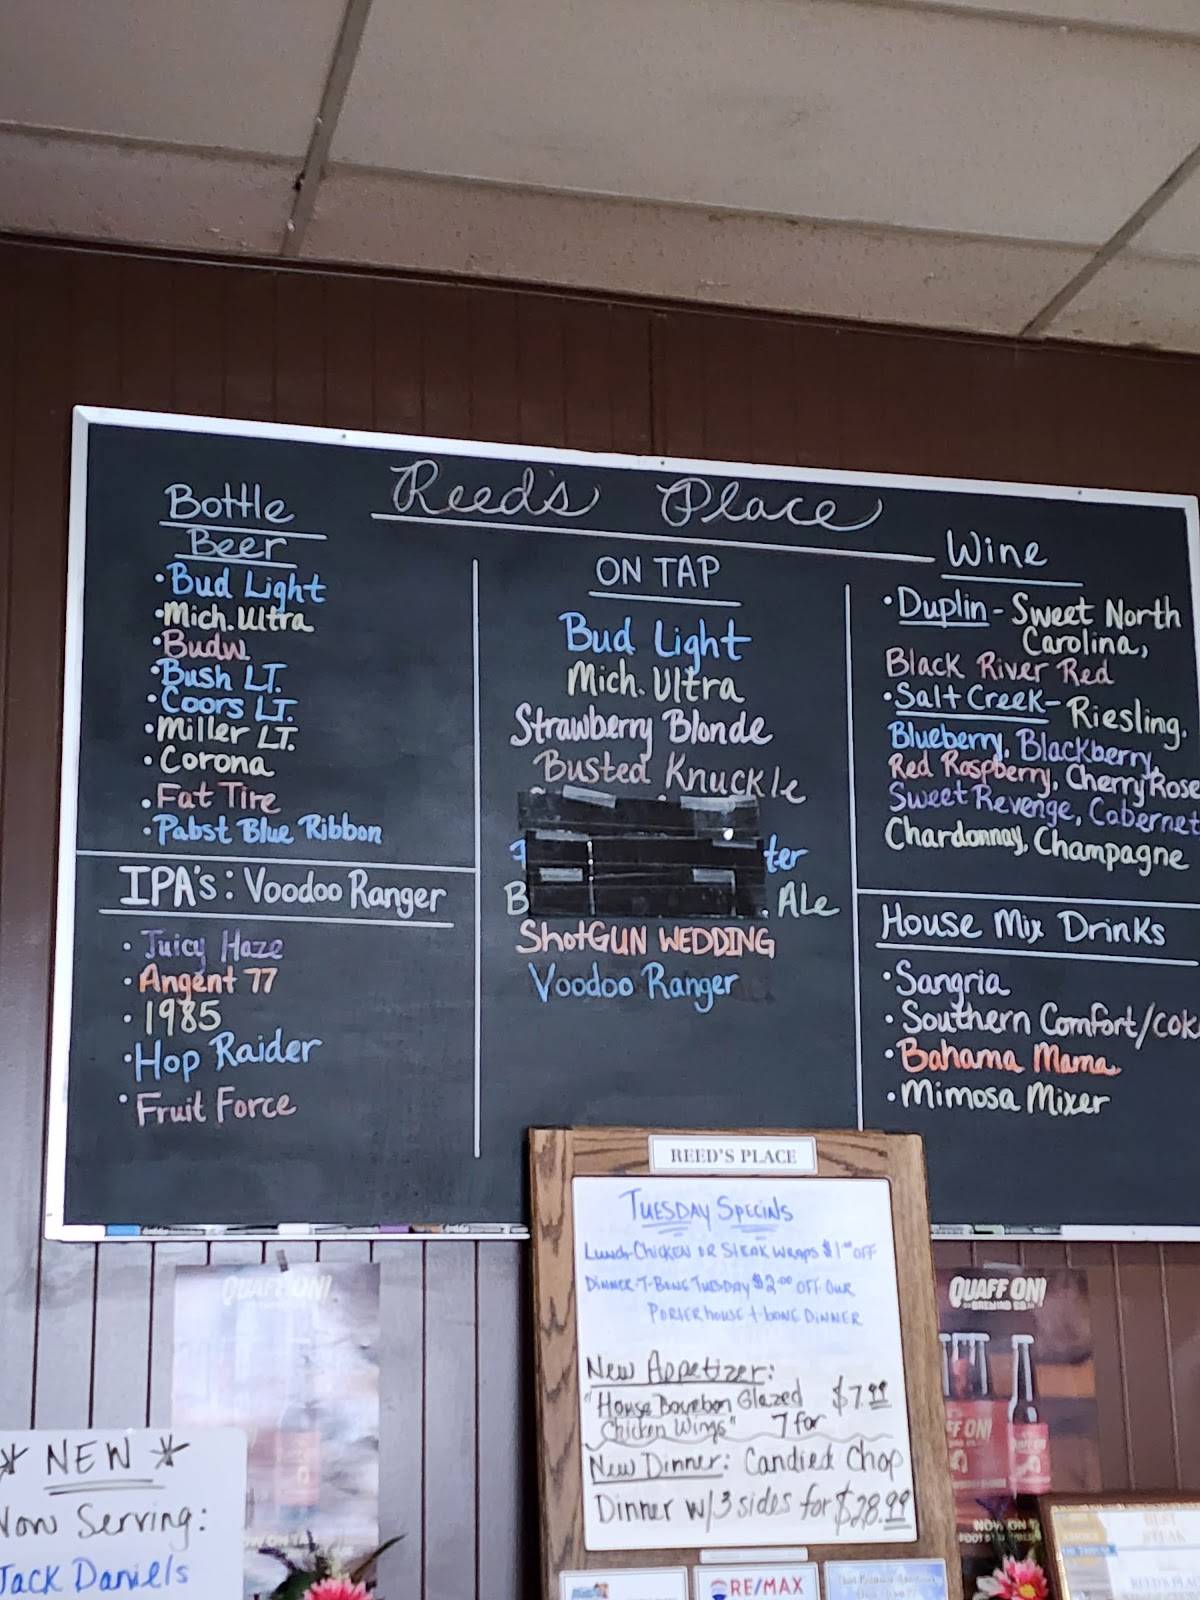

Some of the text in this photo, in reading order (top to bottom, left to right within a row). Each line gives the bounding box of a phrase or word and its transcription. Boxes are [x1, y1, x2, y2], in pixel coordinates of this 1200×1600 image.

[164, 483, 295, 523] Bottle
[391, 459, 883, 532] Reed's Place
[187, 528, 287, 561] Beer
[947, 529, 1048, 568] Wine
[166, 562, 327, 613] Bud Light
[596, 556, 721, 589] ON TAP
[237, 607, 314, 633] Ultra
[1012, 592, 1096, 627] Sweet
[1105, 595, 1182, 631] North
[558, 611, 753, 676] Bud Light
[1022, 625, 1149, 659] Carolina,
[157, 659, 233, 692] Bush
[567, 658, 746, 704] Mich. Ultra
[886, 647, 1116, 687] Black River Red
[161, 686, 244, 718] Coors
[895, 683, 962, 711] Salt
[157, 716, 250, 743] Miller
[509, 702, 774, 761] Strawberry Blonde
[159, 745, 276, 777] Corona
[532, 748, 652, 785] Busted
[888, 752, 934, 781] Red
[1065, 762, 1146, 808] Cherry
[1150, 769, 1200, 800] Rose
[156, 780, 281, 814] Fat Tire
[889, 781, 969, 812] Sweet
[970, 783, 1083, 828] Revenge,
[152, 812, 384, 846] Pabst Blue Ribbon
[1033, 825, 1190, 877] Champagne
[244, 866, 343, 905] Voodoo
[348, 868, 447, 919] Ranger
[658, 926, 777, 959] WEDDING
[881, 902, 983, 940] House
[993, 908, 1046, 944] Mix
[140, 928, 285, 971] Juicy Haze
[243, 967, 279, 994] 77
[528, 961, 741, 1013] Voodoo Ranger
[895, 959, 1011, 1004] Sangria
[144, 999, 223, 1037] 1985
[901, 999, 1200, 1051] Southern Comfort/cok
[134, 1027, 324, 1083] Hop Raider
[895, 1037, 1123, 1076] Bahama Mama
[136, 1086, 298, 1127] Fruit Force
[900, 1078, 1111, 1116] Mimosa Mixer
[670, 1148, 798, 1165] REED'S PLACE
[949, 1276, 1009, 1308] QUAFF
[586, 1355, 636, 1381] New
[737, 1379, 805, 1409] Glazed
[771, 1412, 789, 1439] 7
[794, 1412, 827, 1437] for
[46, 1436, 133, 1476] NEW
[588, 1453, 637, 1480] New
[744, 1445, 834, 1476] Candied
[846, 1440, 904, 1482] Chop
[596, 1490, 673, 1525] Dinner
[737, 1488, 793, 1517] sides
[799, 1487, 831, 1521] for
[0, 1554, 190, 1595] Jack Daniels
[730, 1576, 804, 1597] RE/MAX
